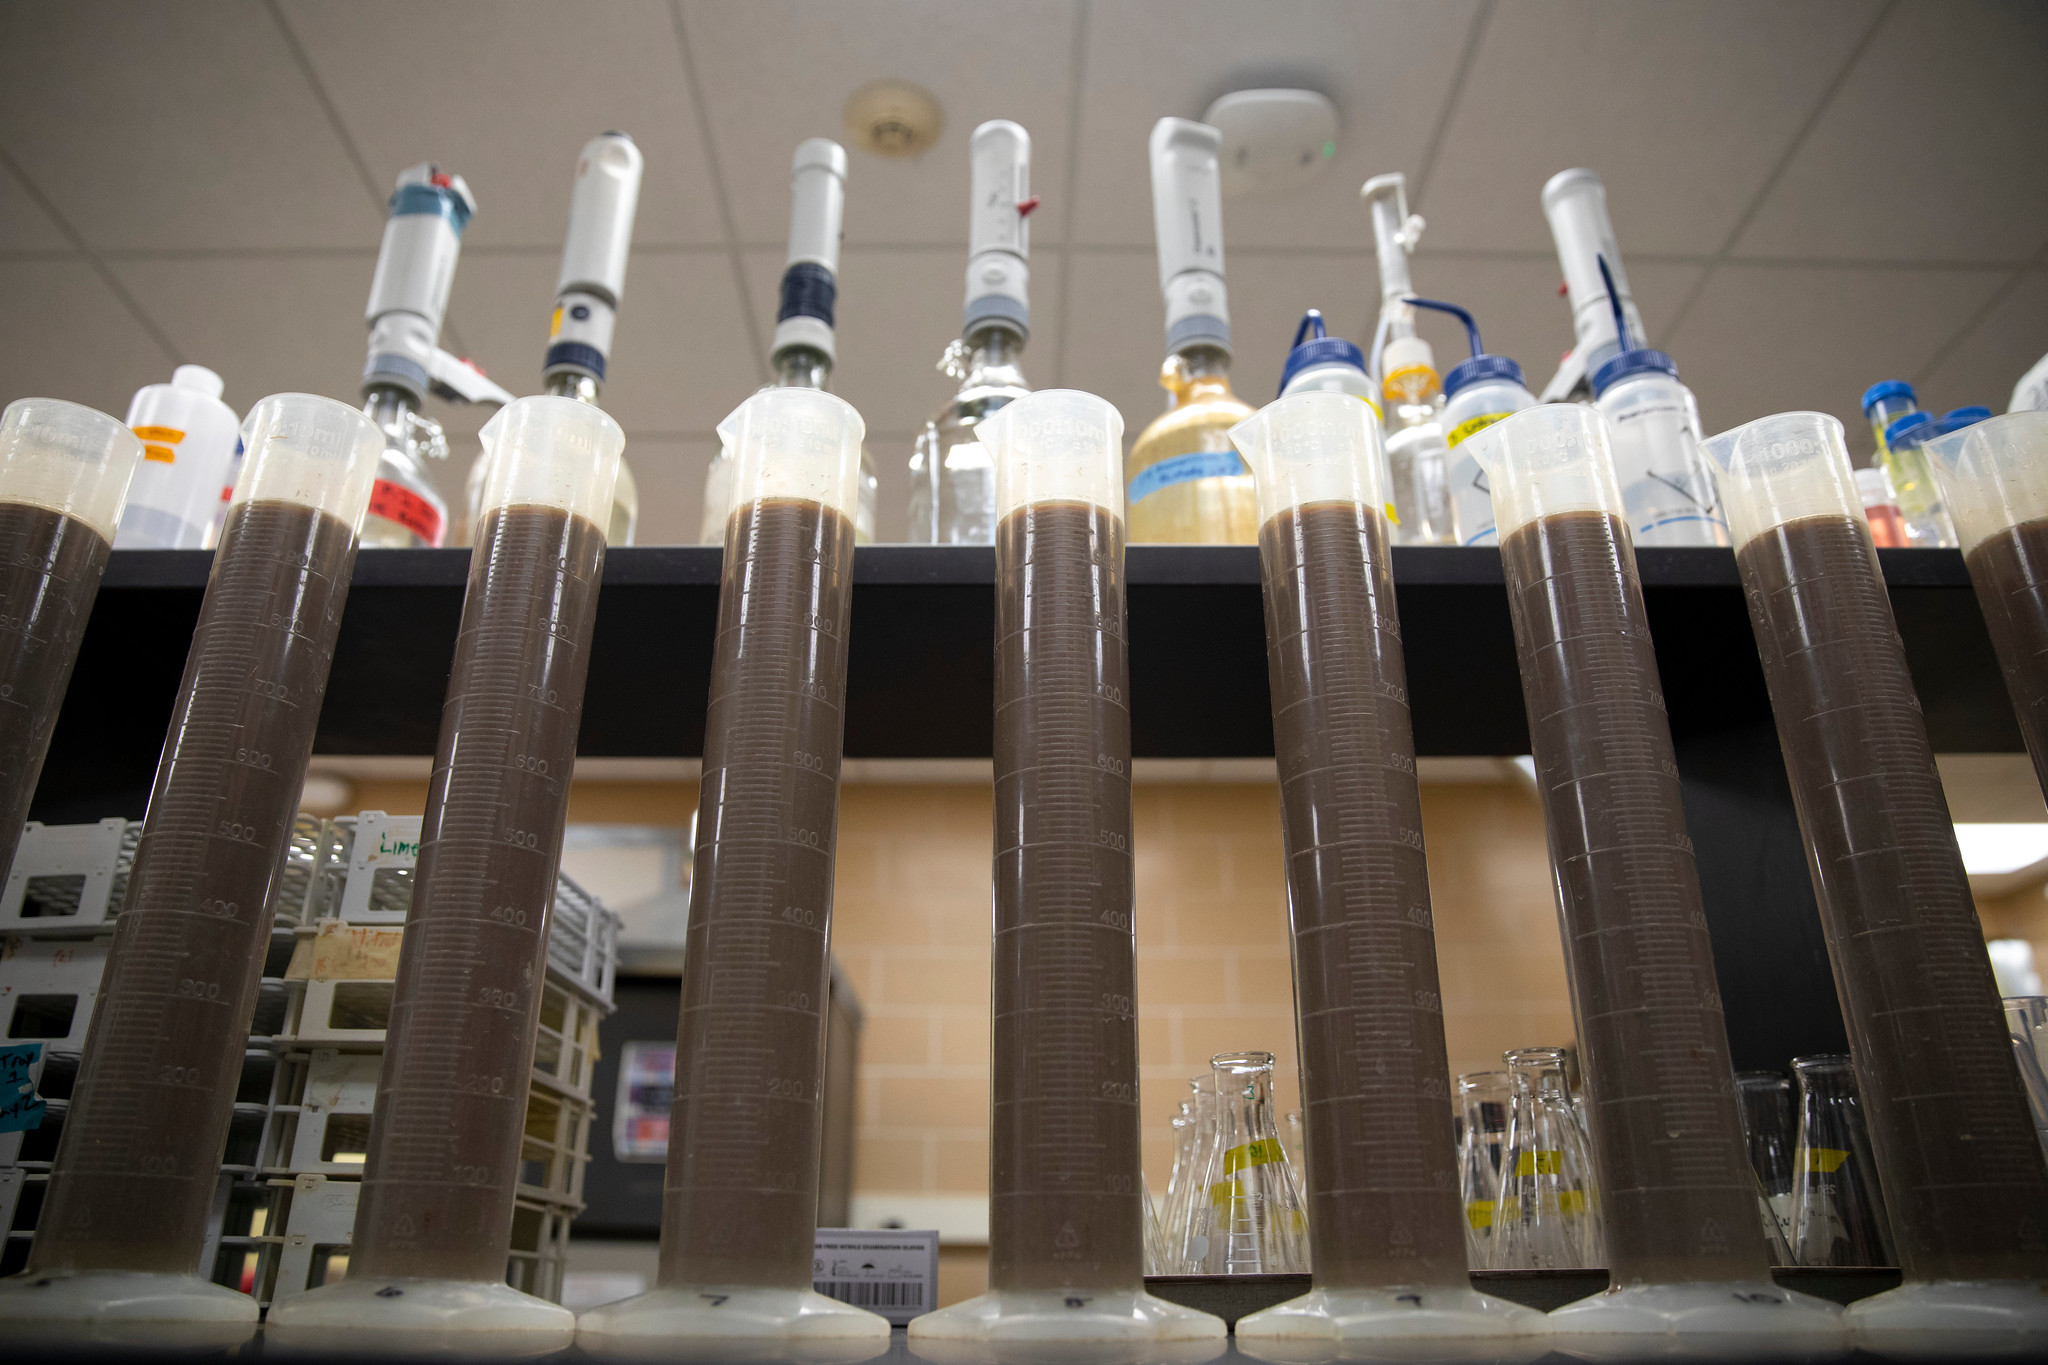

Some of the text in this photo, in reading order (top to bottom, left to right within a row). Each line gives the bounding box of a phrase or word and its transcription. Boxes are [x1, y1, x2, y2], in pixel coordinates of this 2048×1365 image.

[286, 550, 320, 571] 900
[270, 612, 305, 633] 800
[538, 617, 568, 638] 800
[254, 678, 289, 700] 700
[527, 683, 558, 704] 700
[1099, 683, 1121, 702] 700
[236, 747, 272, 768] 600
[515, 753, 549, 775] 600
[1098, 753, 1124, 775] 600
[1391, 752, 1414, 773] 600
[218, 820, 257, 842] 500
[504, 827, 538, 849] 500
[789, 827, 818, 846] 500
[1100, 829, 1126, 850] 500
[1399, 828, 1422, 849] 500
[201, 897, 239, 918] 400
[490, 906, 528, 926] 400
[781, 906, 815, 925] 400
[1407, 907, 1430, 927] 400
[1100, 909, 1127, 928] 400
[180, 978, 220, 999] 300
[1414, 990, 1439, 1010] 300
[159, 1065, 200, 1085] 200
[767, 1077, 804, 1096] 200
[1102, 1080, 1131, 1099] 200
